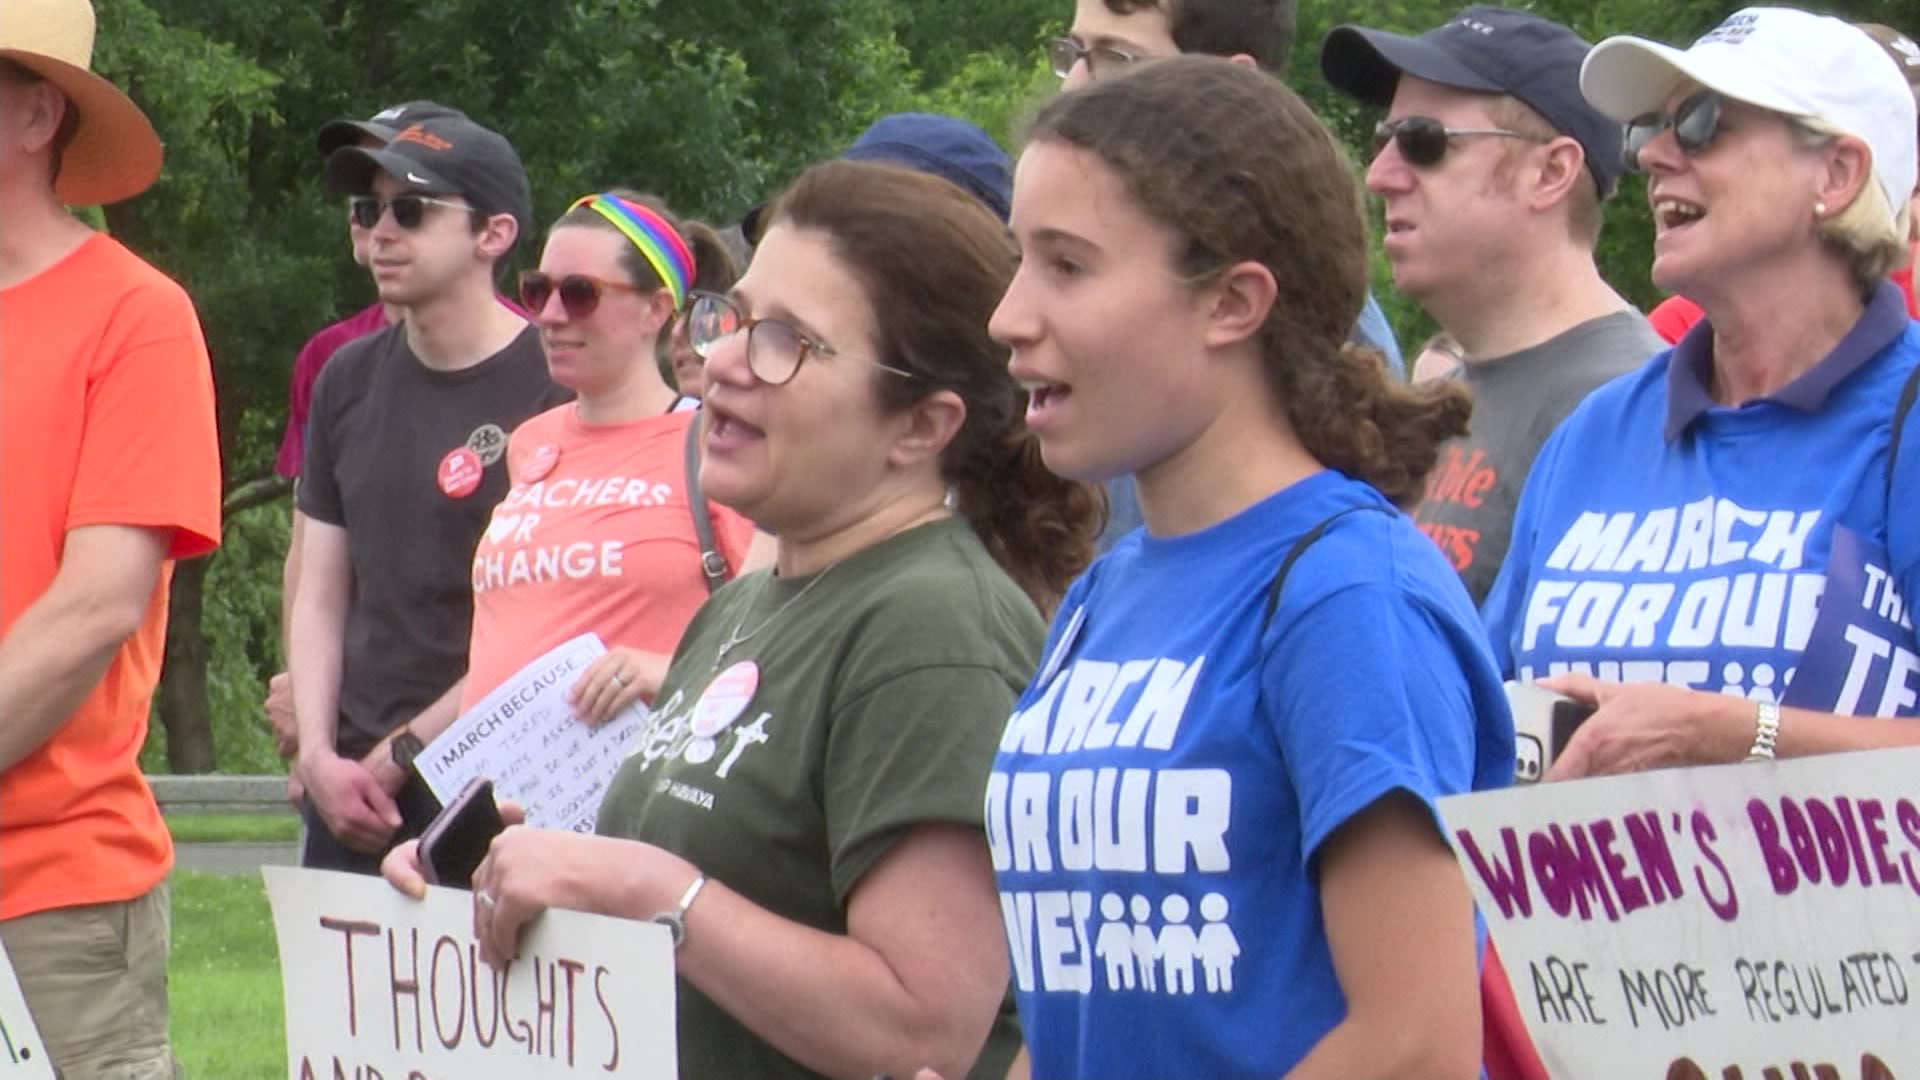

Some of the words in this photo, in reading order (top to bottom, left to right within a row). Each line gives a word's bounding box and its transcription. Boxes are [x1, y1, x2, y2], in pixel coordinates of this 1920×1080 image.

[503, 476, 673, 508] EACHERS
[1545, 495, 1822, 574] MARCH
[472, 541, 624, 593] CHANGE
[1523, 579, 1675, 652] FOR
[441, 714, 501, 764] MARCH
[500, 658, 579, 720] BECAUSE
[984, 771, 1053, 873] OR
[1058, 767, 1232, 874] OUR
[1455, 808, 1740, 923] WOMEN'S
[1746, 795, 1920, 897] BODIES
[1000, 890, 1093, 994] VES
[320, 915, 620, 1072] THOUGHTS
[1530, 955, 1606, 1024] ARE
[1619, 963, 1717, 1030] MORE
[1735, 951, 1909, 1023] REGULATED
